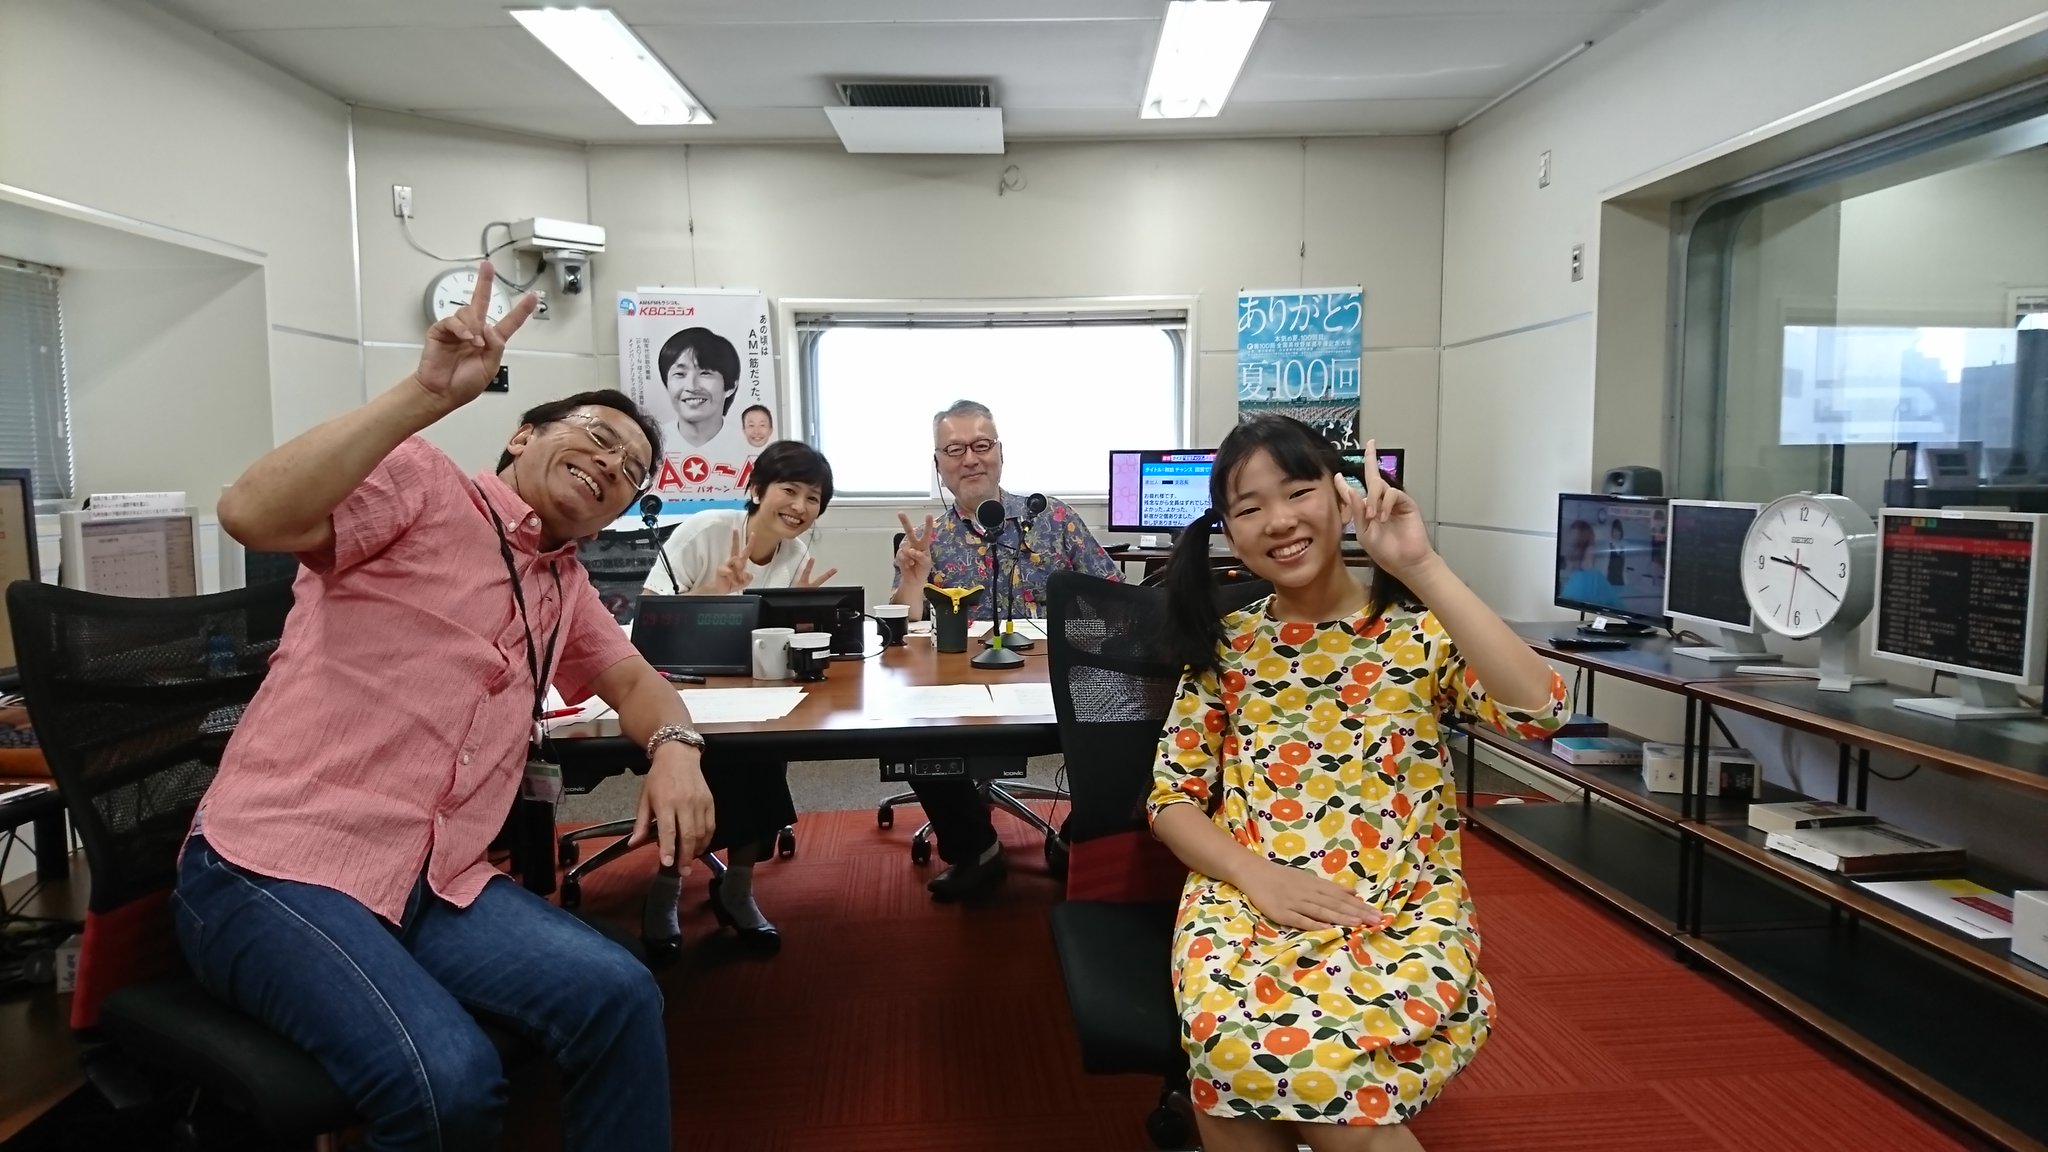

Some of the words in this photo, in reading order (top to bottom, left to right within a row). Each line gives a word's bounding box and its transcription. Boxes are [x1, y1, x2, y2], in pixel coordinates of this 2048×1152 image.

[639, 306, 695, 316] KBCラジオ
[1238, 294, 1361, 336] ありがとう
[760, 314, 769, 355] あの頃は
[748, 329, 761, 402] AM一筋だった。
[1238, 358, 1361, 401] 夏100回
[1800, 506, 1809, 522] 12
[1791, 536, 1814, 544] SEIKO
[1758, 555, 1765, 570] 9
[1838, 562, 1847, 578] 3
[1793, 610, 1801, 626] 6
